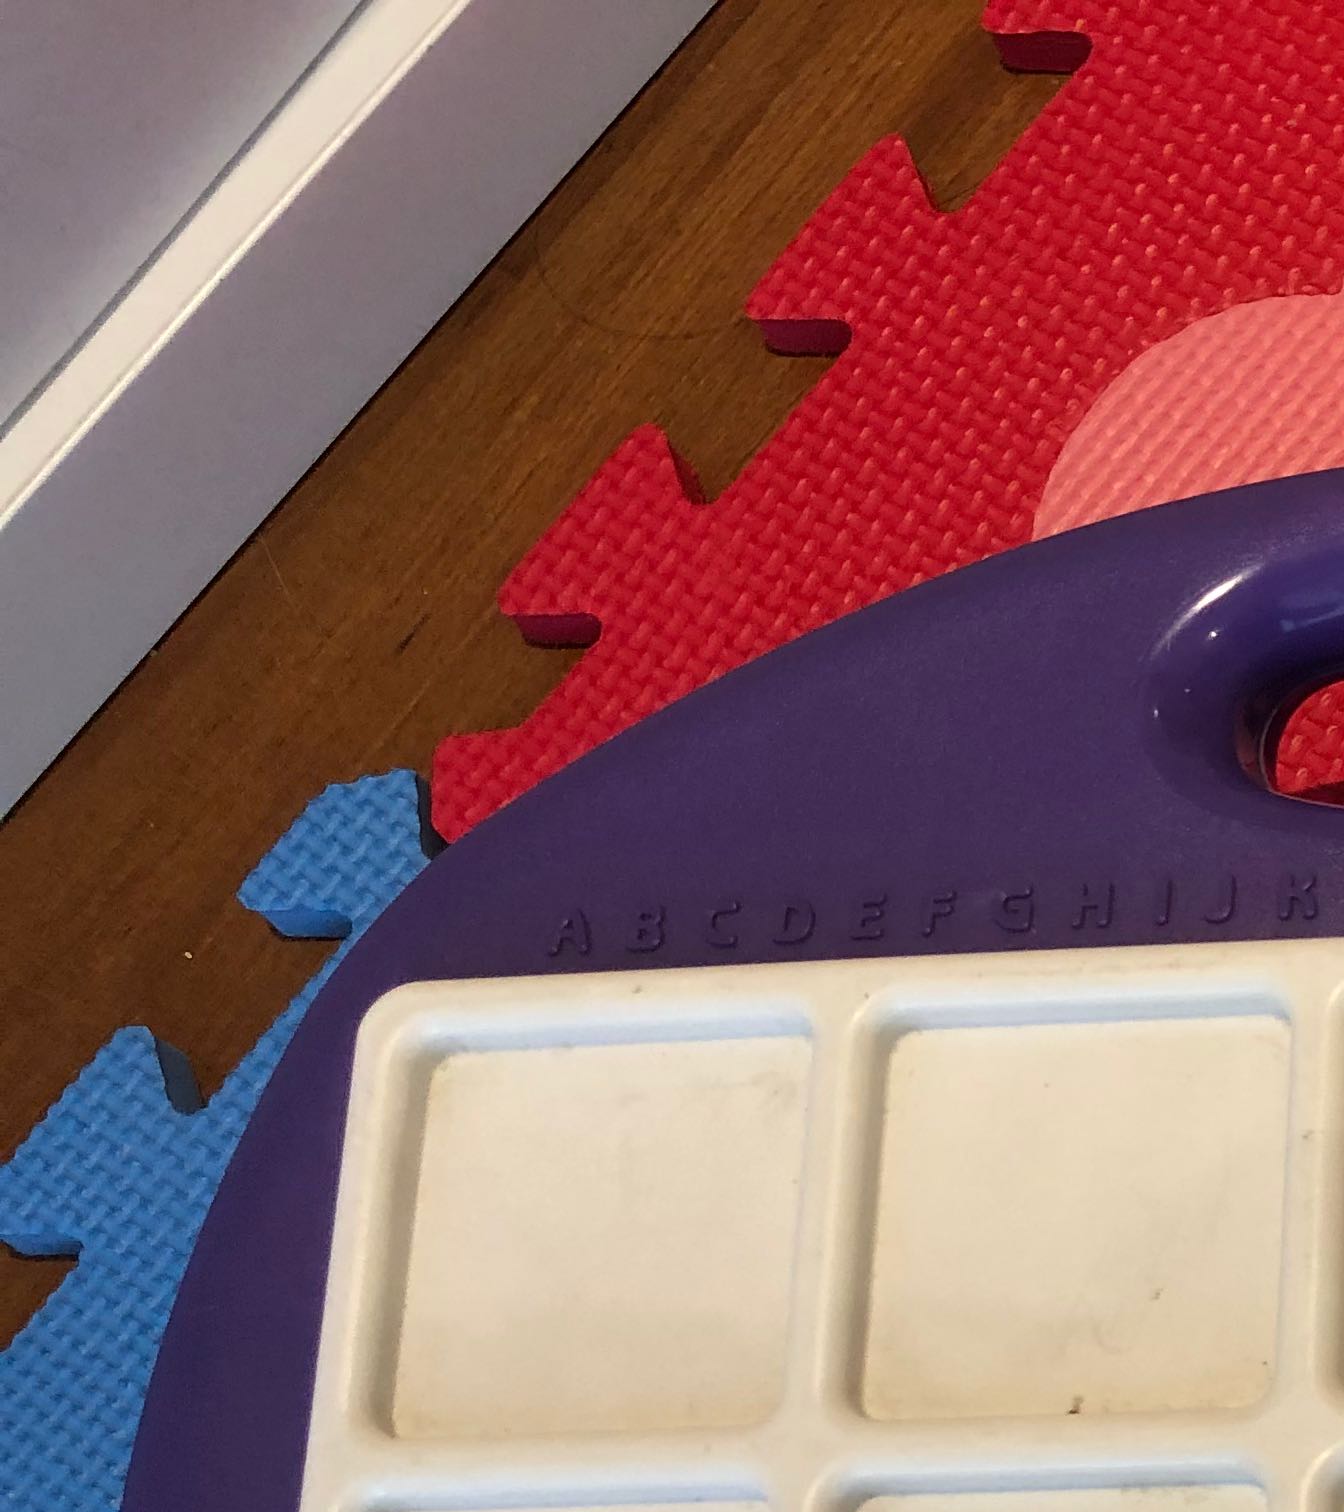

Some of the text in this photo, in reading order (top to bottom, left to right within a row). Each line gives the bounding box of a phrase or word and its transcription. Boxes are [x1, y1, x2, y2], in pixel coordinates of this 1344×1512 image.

[548, 908, 592, 957] A
[626, 905, 665, 953] B
[707, 901, 741, 949] C
[773, 902, 816, 947] D
[851, 894, 888, 941] E
[921, 889, 956, 937] F
[994, 883, 1034, 934] G
[1072, 882, 1116, 930] H
[1205, 874, 1237, 923] J
[1277, 872, 1318, 921] K
